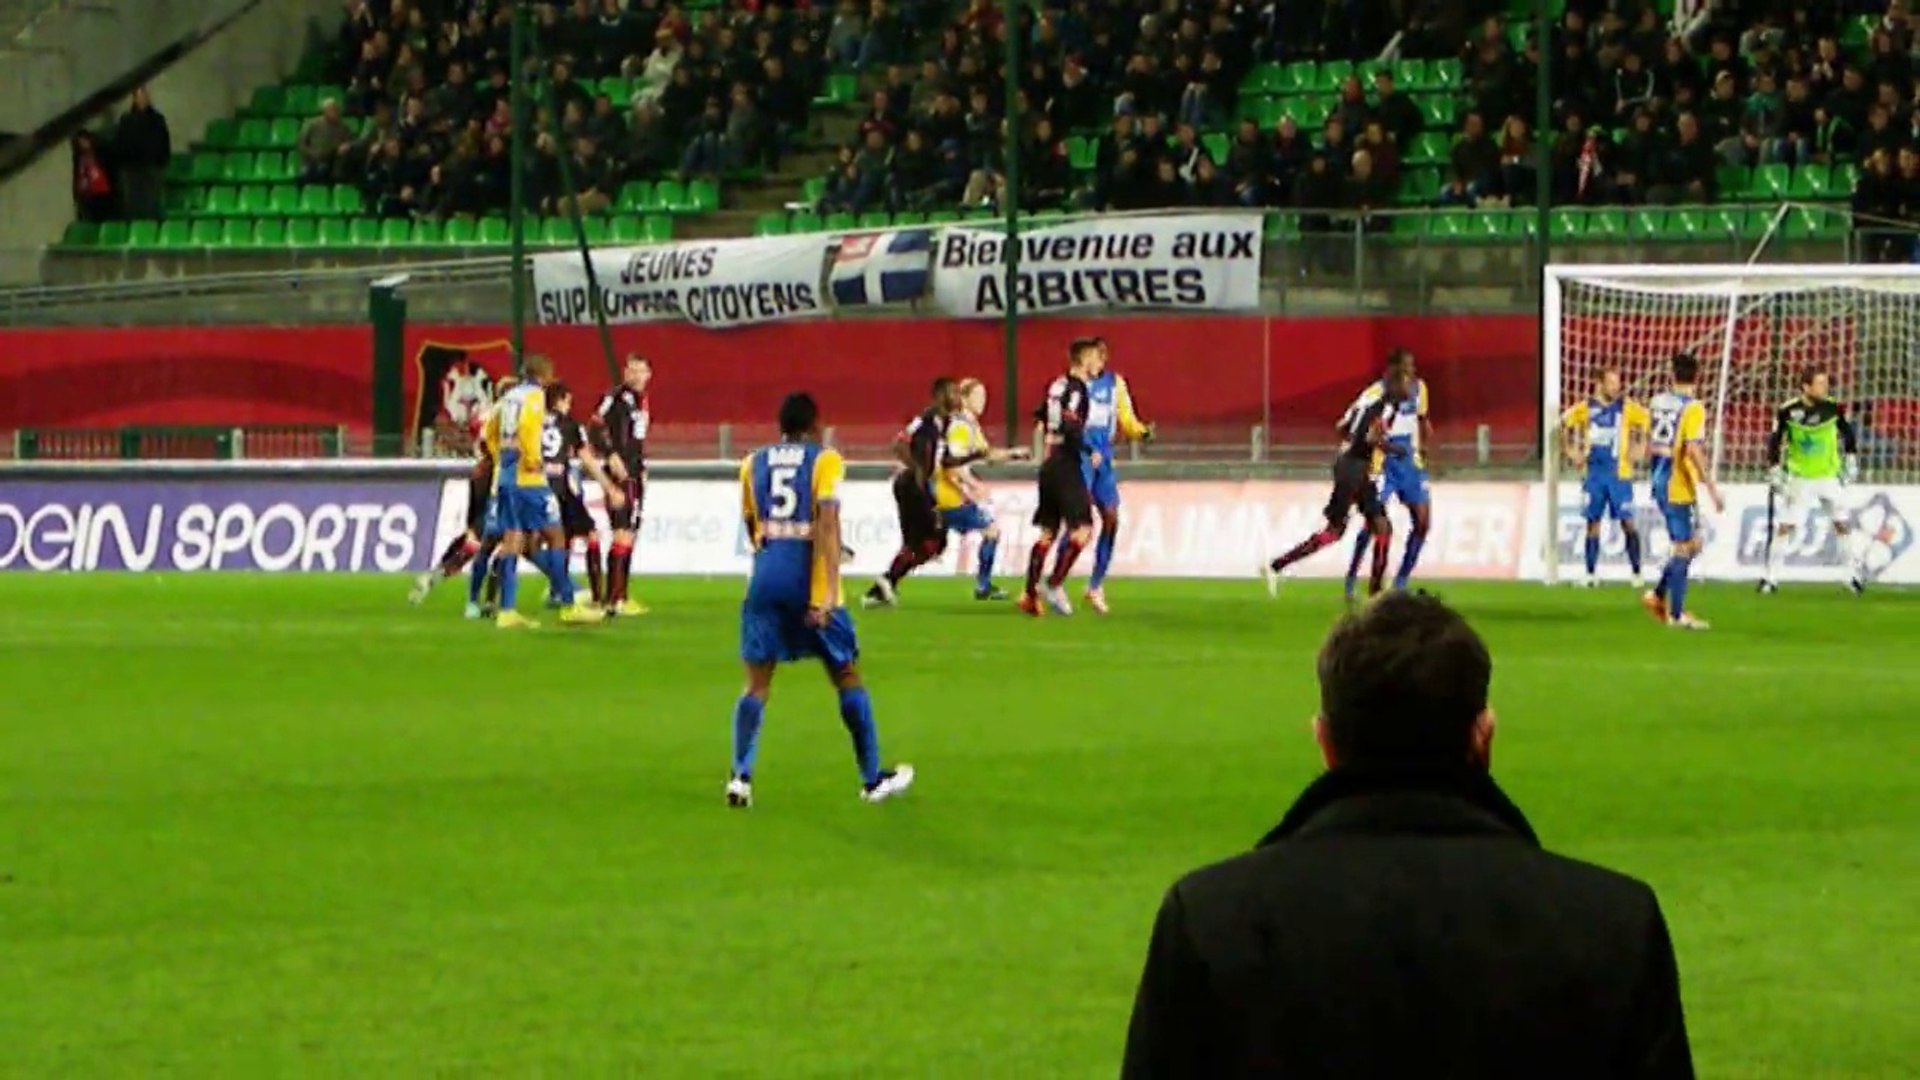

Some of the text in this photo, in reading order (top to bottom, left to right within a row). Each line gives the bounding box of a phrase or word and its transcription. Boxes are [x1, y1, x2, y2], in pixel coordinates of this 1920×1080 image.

[1172, 230, 1254, 259] aux
[620, 247, 718, 284] JEUNES
[686, 282, 817, 322] CITOYENS
[976, 268, 1206, 312] ARBITRES
[542, 426, 563, 458] 9
[770, 467, 798, 519] 5
[172, 503, 415, 572] SPORTS
